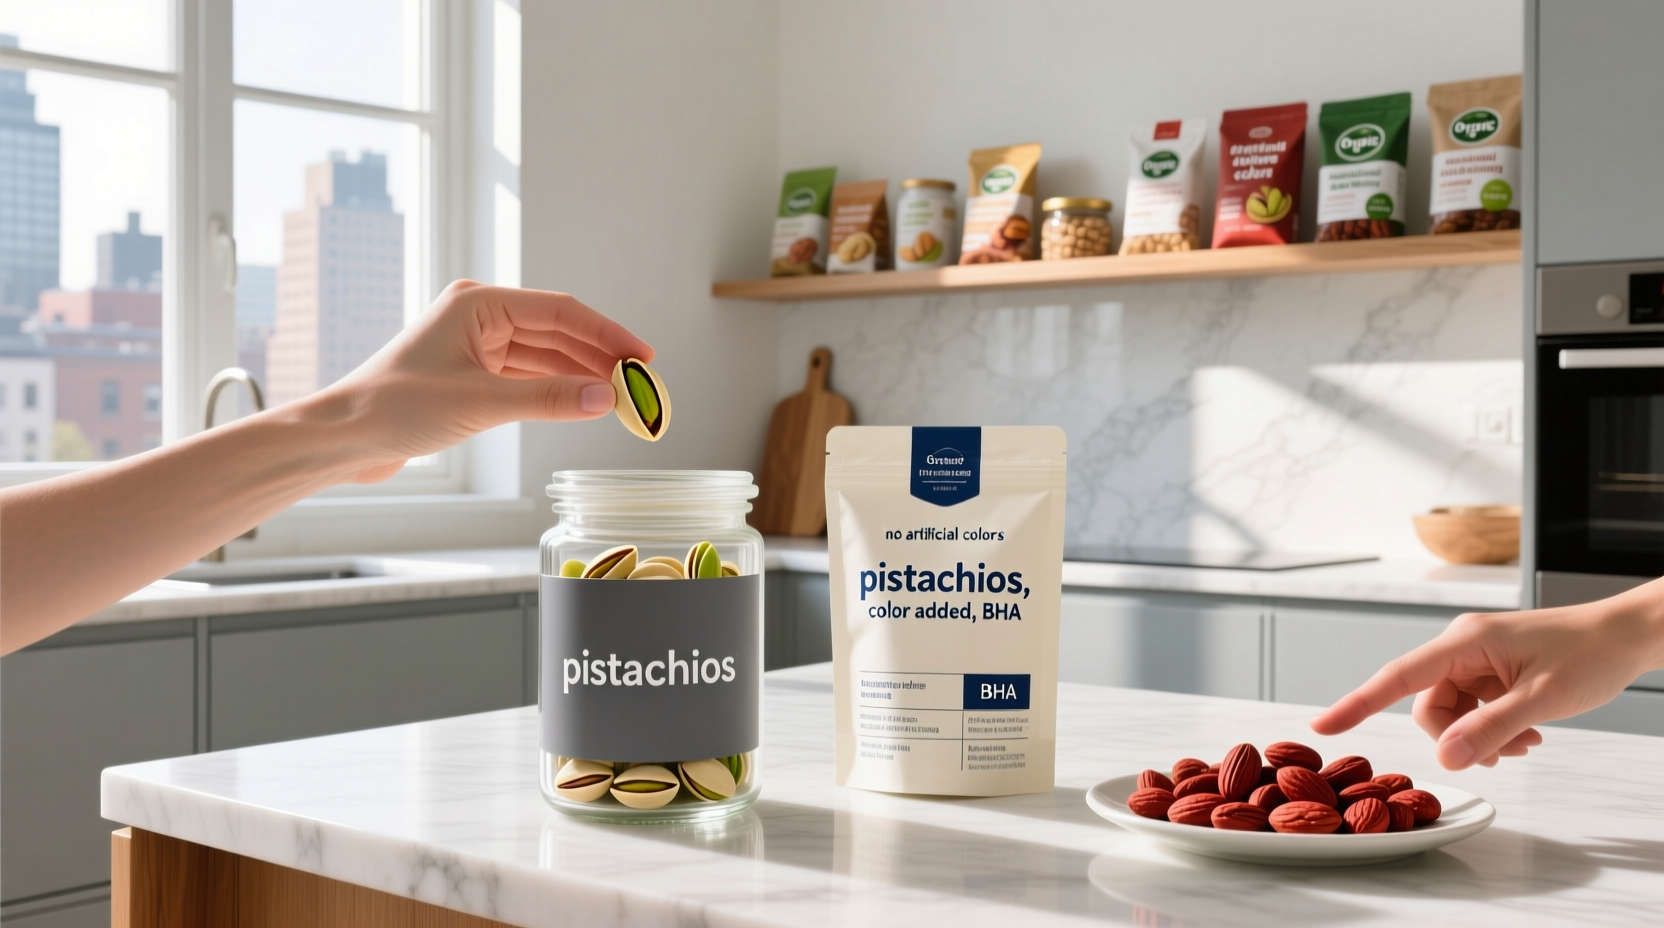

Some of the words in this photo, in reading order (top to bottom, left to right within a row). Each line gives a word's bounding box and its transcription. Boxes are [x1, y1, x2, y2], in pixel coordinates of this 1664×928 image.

[885, 529, 903, 541] no
[905, 527, 959, 541] artificial
[962, 527, 1005, 541] colors
[860, 561, 1031, 601] pistachios,
[868, 600, 911, 619] color
[914, 601, 977, 624] added,
[982, 602, 1022, 621] BHA
[563, 649, 736, 694] pistachios
[980, 683, 1017, 700] BHA
